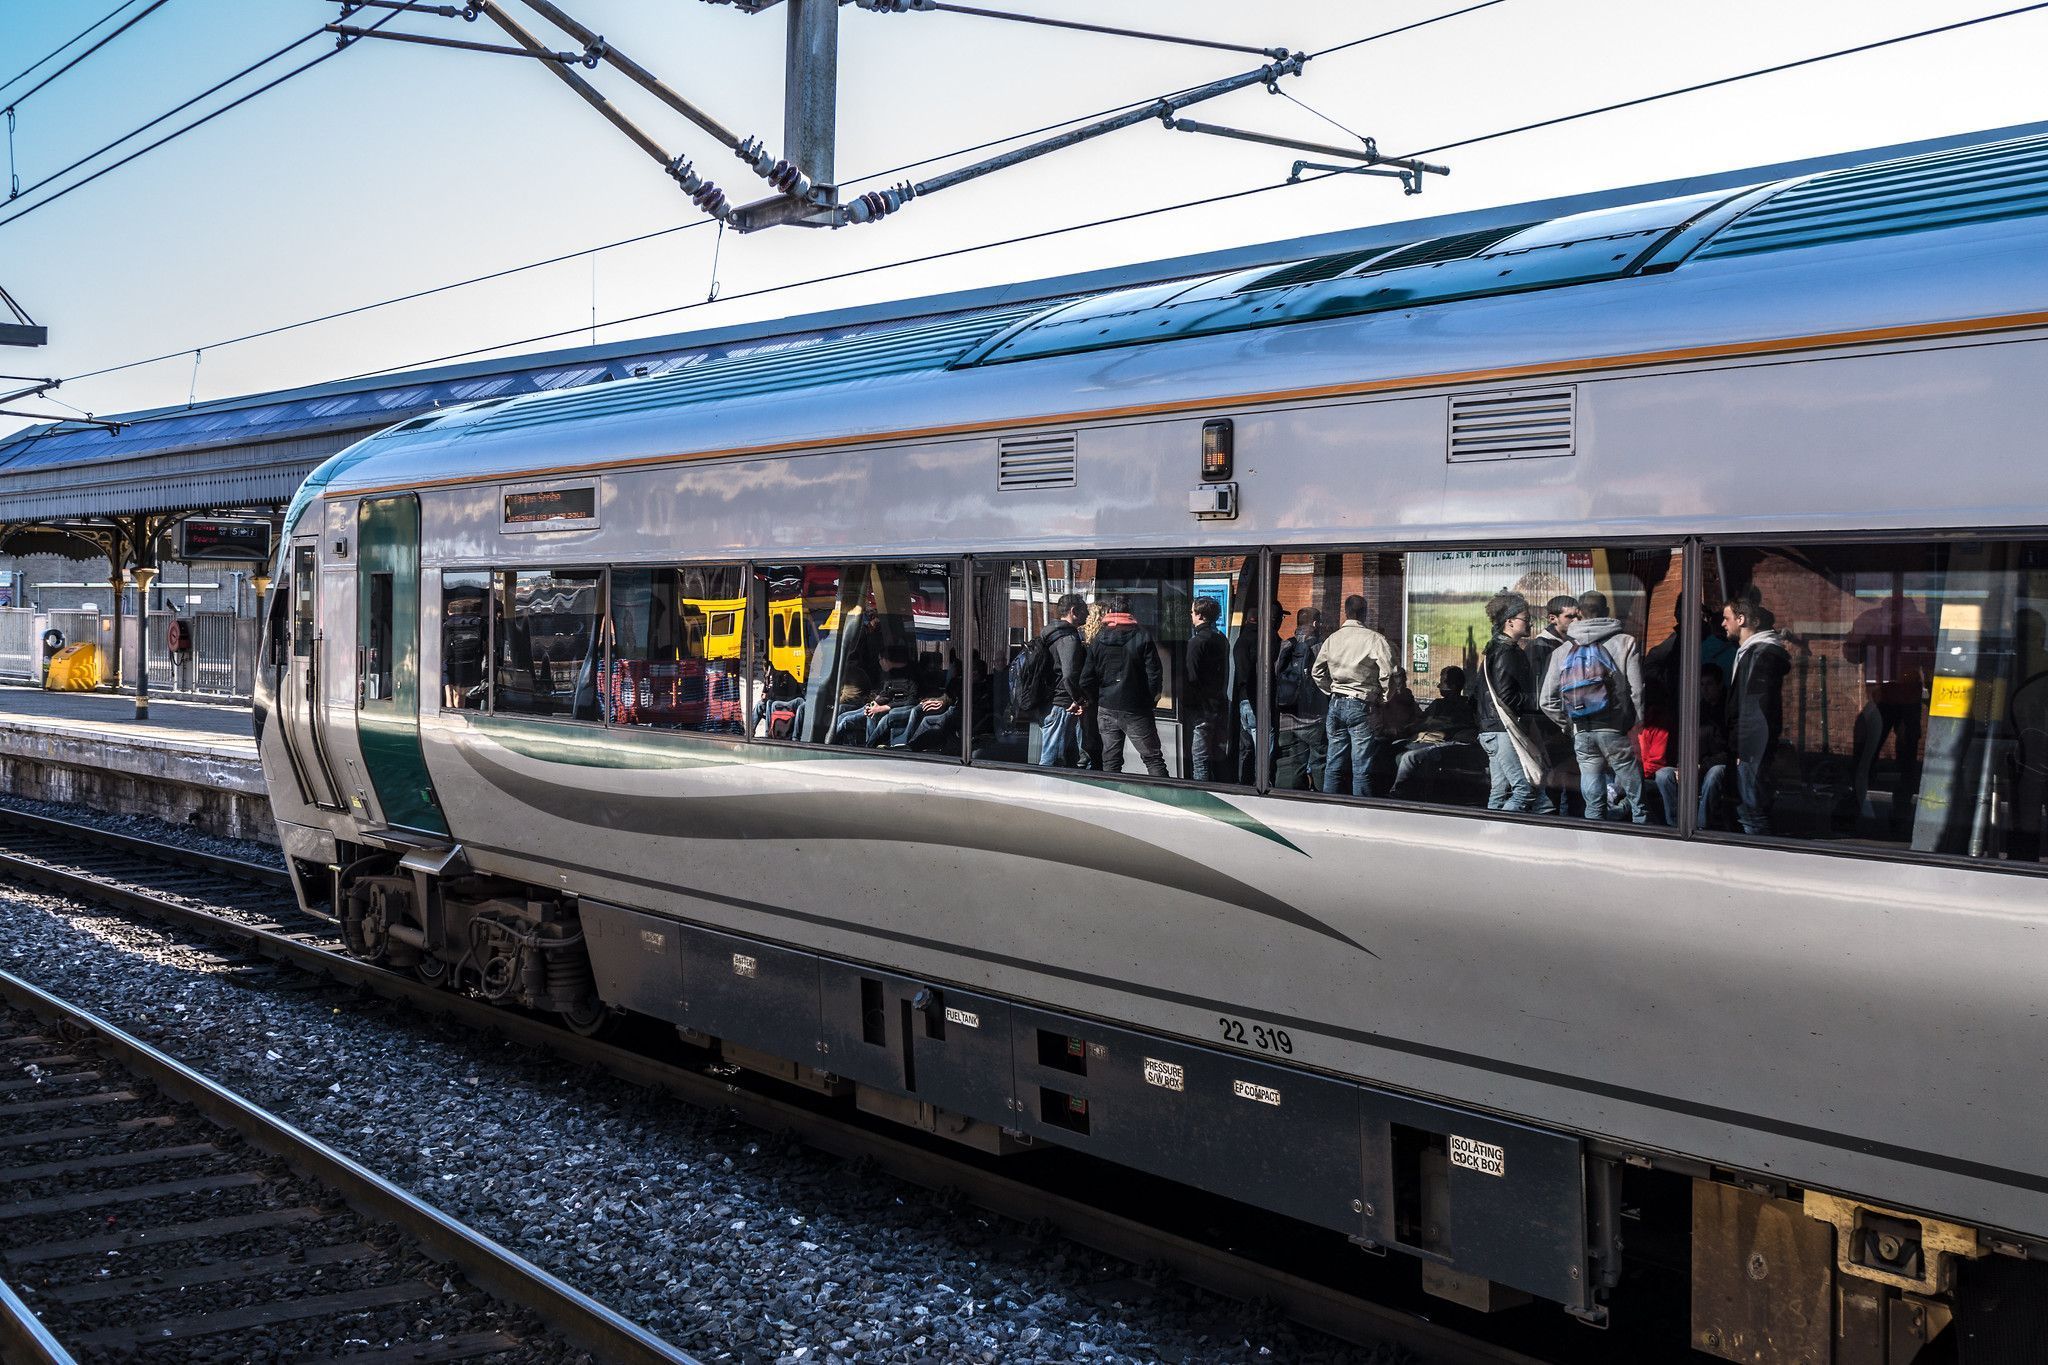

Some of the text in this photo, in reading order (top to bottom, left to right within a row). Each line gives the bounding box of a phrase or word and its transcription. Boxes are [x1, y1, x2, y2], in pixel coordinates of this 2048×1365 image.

[946, 1009, 979, 1026] FUEL TANK
[1219, 1018, 1293, 1054] 22 319
[1145, 1060, 1183, 1078] PRESSURE
[1148, 1071, 1180, 1089] S/W BOX
[1235, 1082, 1244, 1094] EP
[1451, 1137, 1502, 1160] ISOLATING
[1453, 1151, 1502, 1173] COCK BOX
